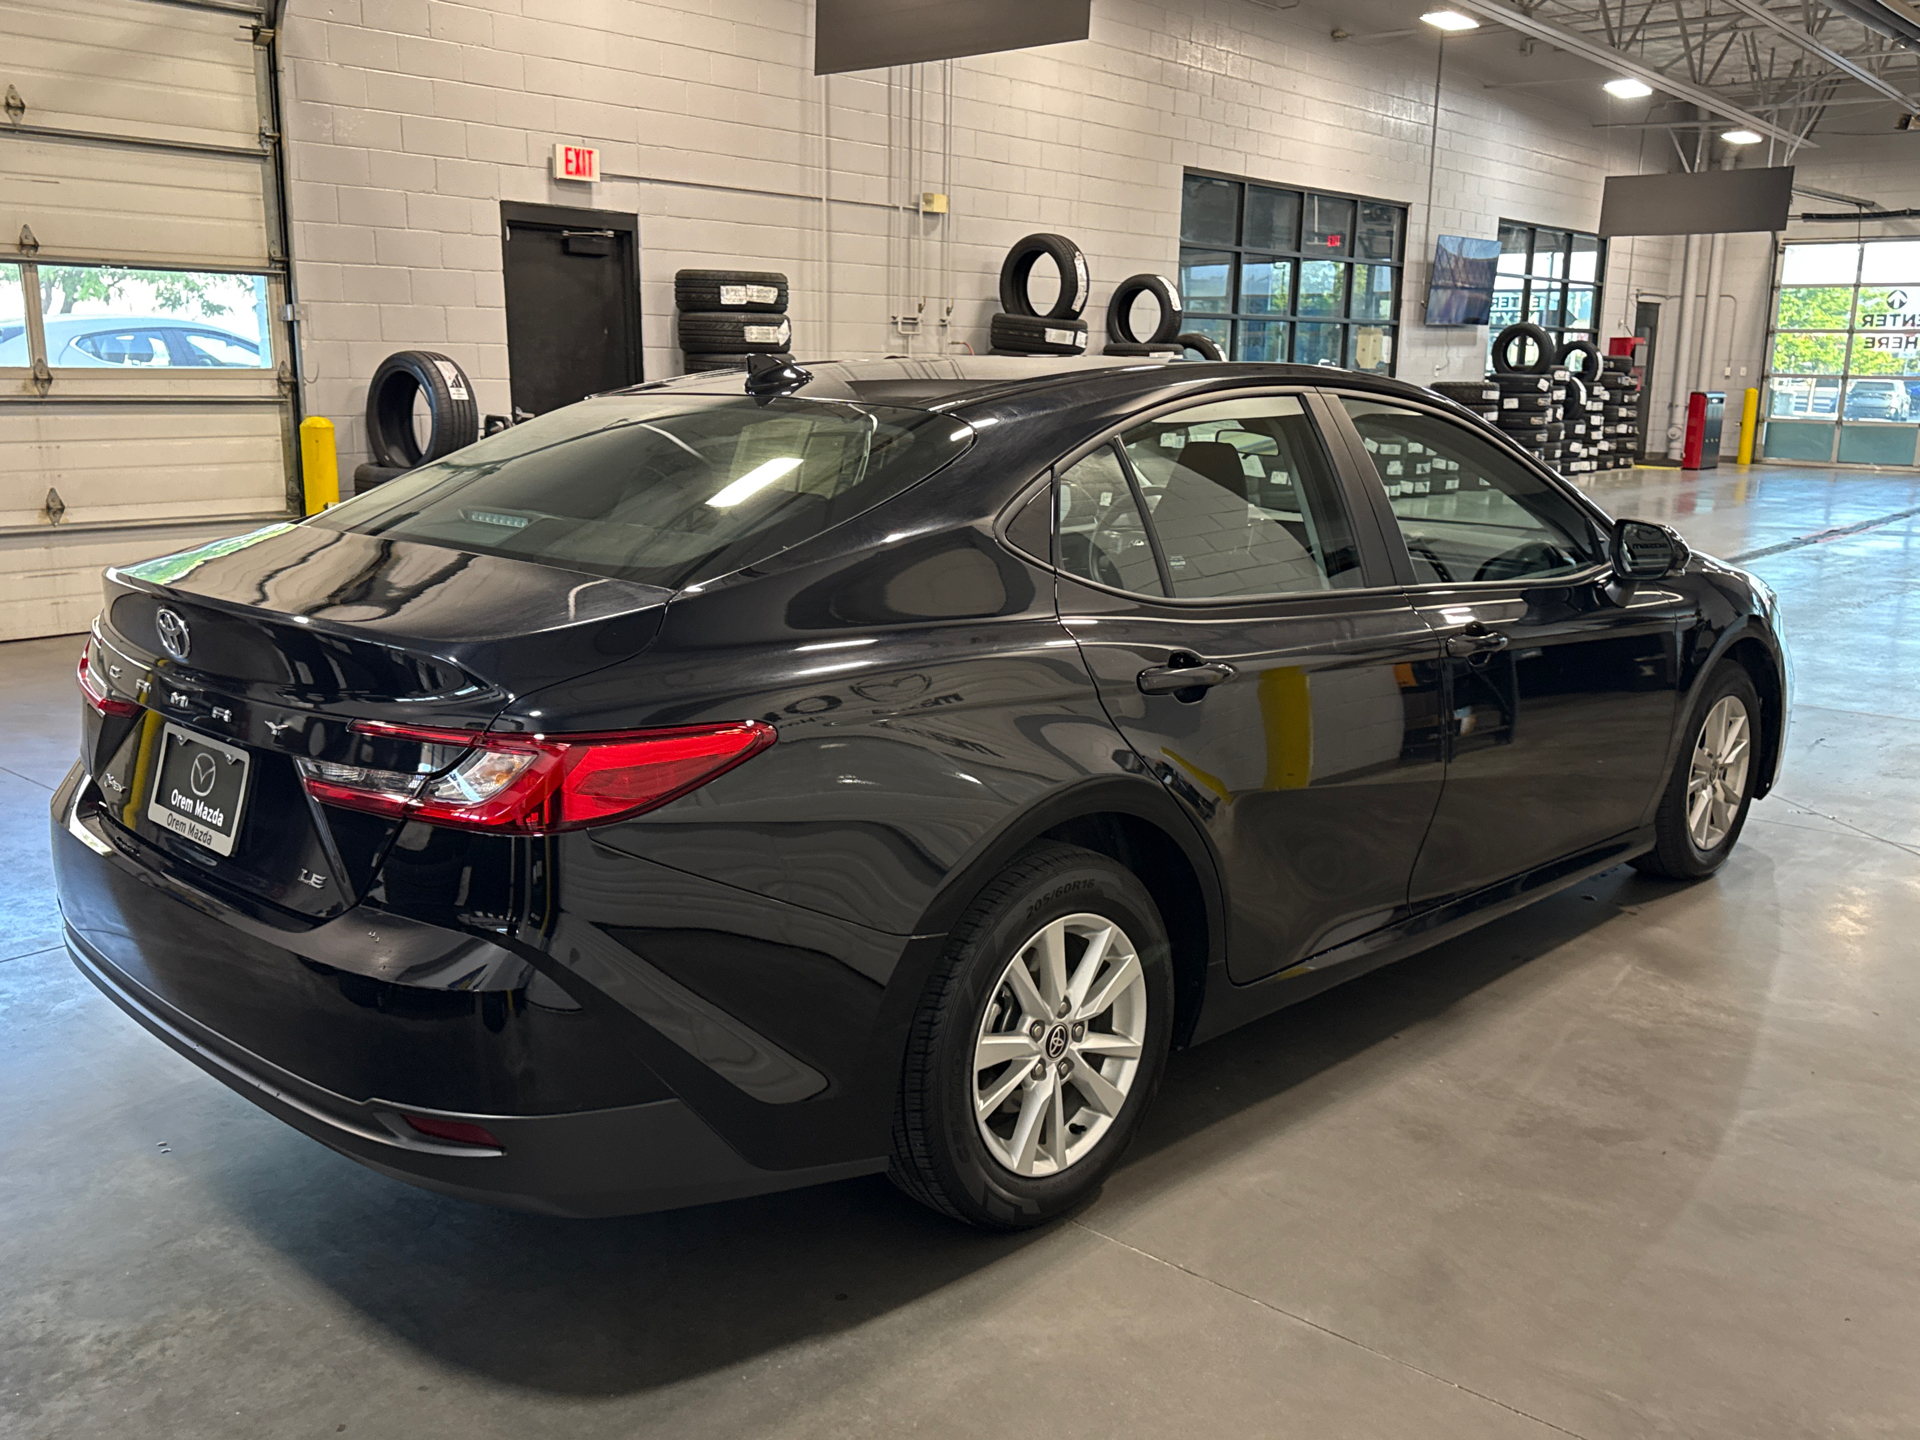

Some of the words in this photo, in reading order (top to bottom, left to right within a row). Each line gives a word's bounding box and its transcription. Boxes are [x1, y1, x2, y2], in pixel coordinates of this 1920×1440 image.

[564, 146, 594, 178] EXIT
[170, 788, 194, 814] Orem
[194, 799, 224, 828] Mazda
[166, 812, 187, 834] Orem
[187, 822, 213, 846] Mazda
[297, 868, 328, 889] LE
